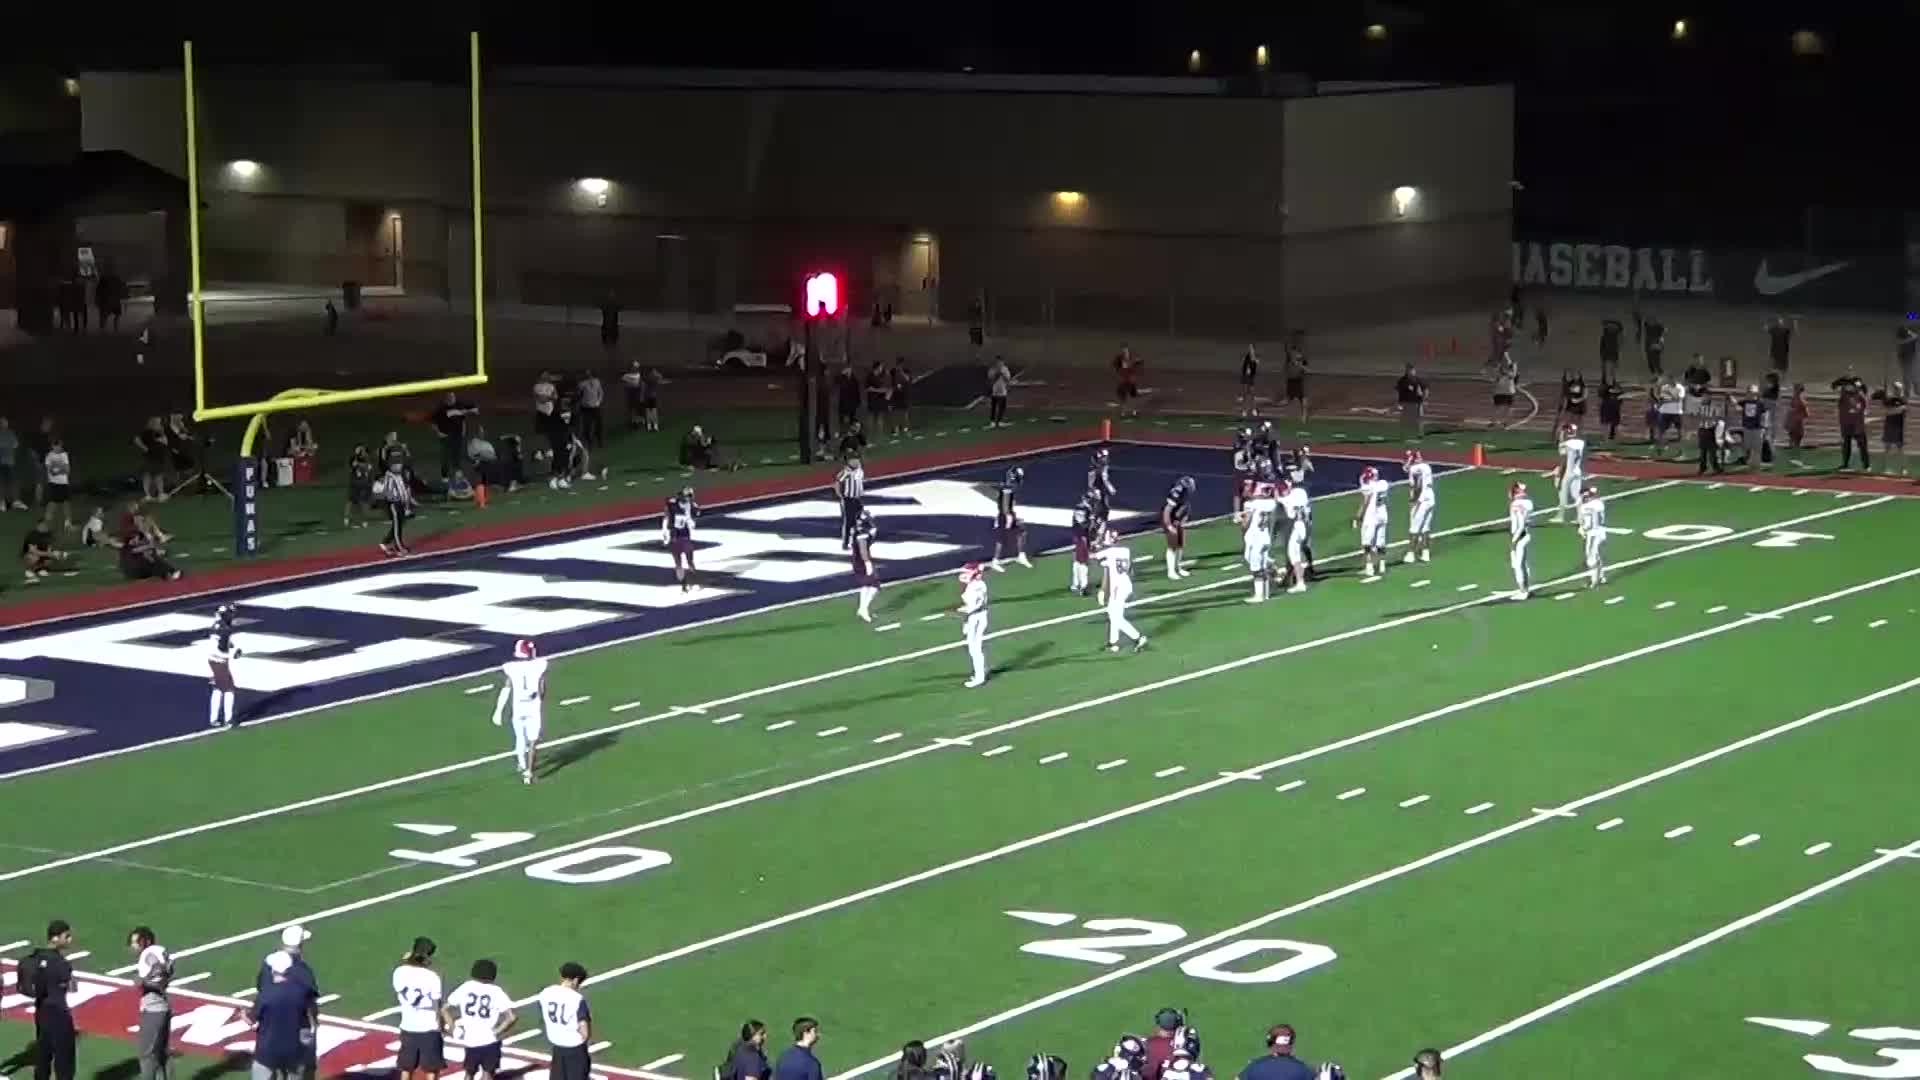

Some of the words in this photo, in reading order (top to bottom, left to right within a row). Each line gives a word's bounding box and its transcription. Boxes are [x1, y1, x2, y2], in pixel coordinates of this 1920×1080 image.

[245, 467, 256, 550] PUMAS
[0, 479, 1150, 750] ERRY
[465, 992, 492, 1019] 28
